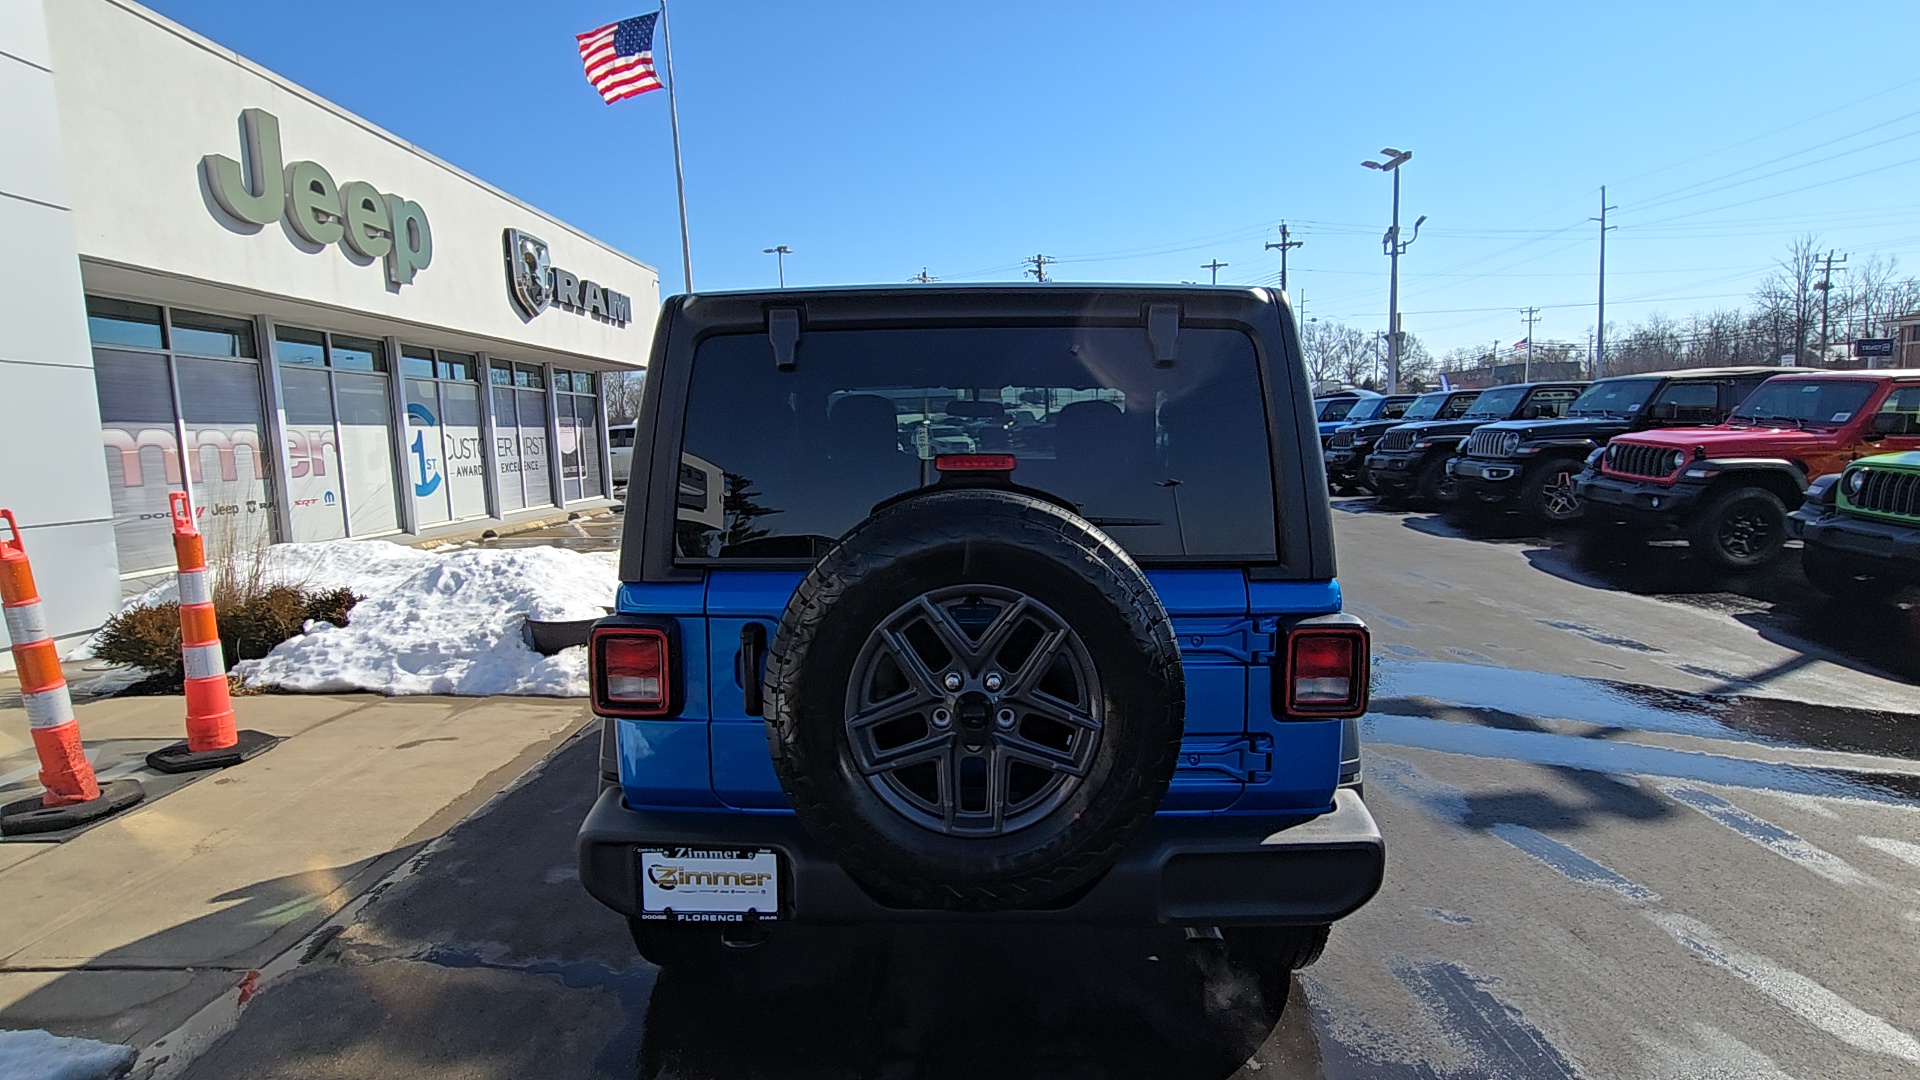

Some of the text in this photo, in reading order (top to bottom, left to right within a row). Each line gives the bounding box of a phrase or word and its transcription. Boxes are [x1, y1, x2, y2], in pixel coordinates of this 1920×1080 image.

[200, 107, 432, 290] Jeep
[551, 267, 632, 327] RAM
[501, 460, 539, 474] EXCELENCE
[211, 503, 240, 517] Jeep
[294, 498, 319, 507] SRT
[674, 847, 741, 859] Zimmer
[655, 865, 773, 887] Zimmer
[677, 914, 744, 922] FLORENCE
